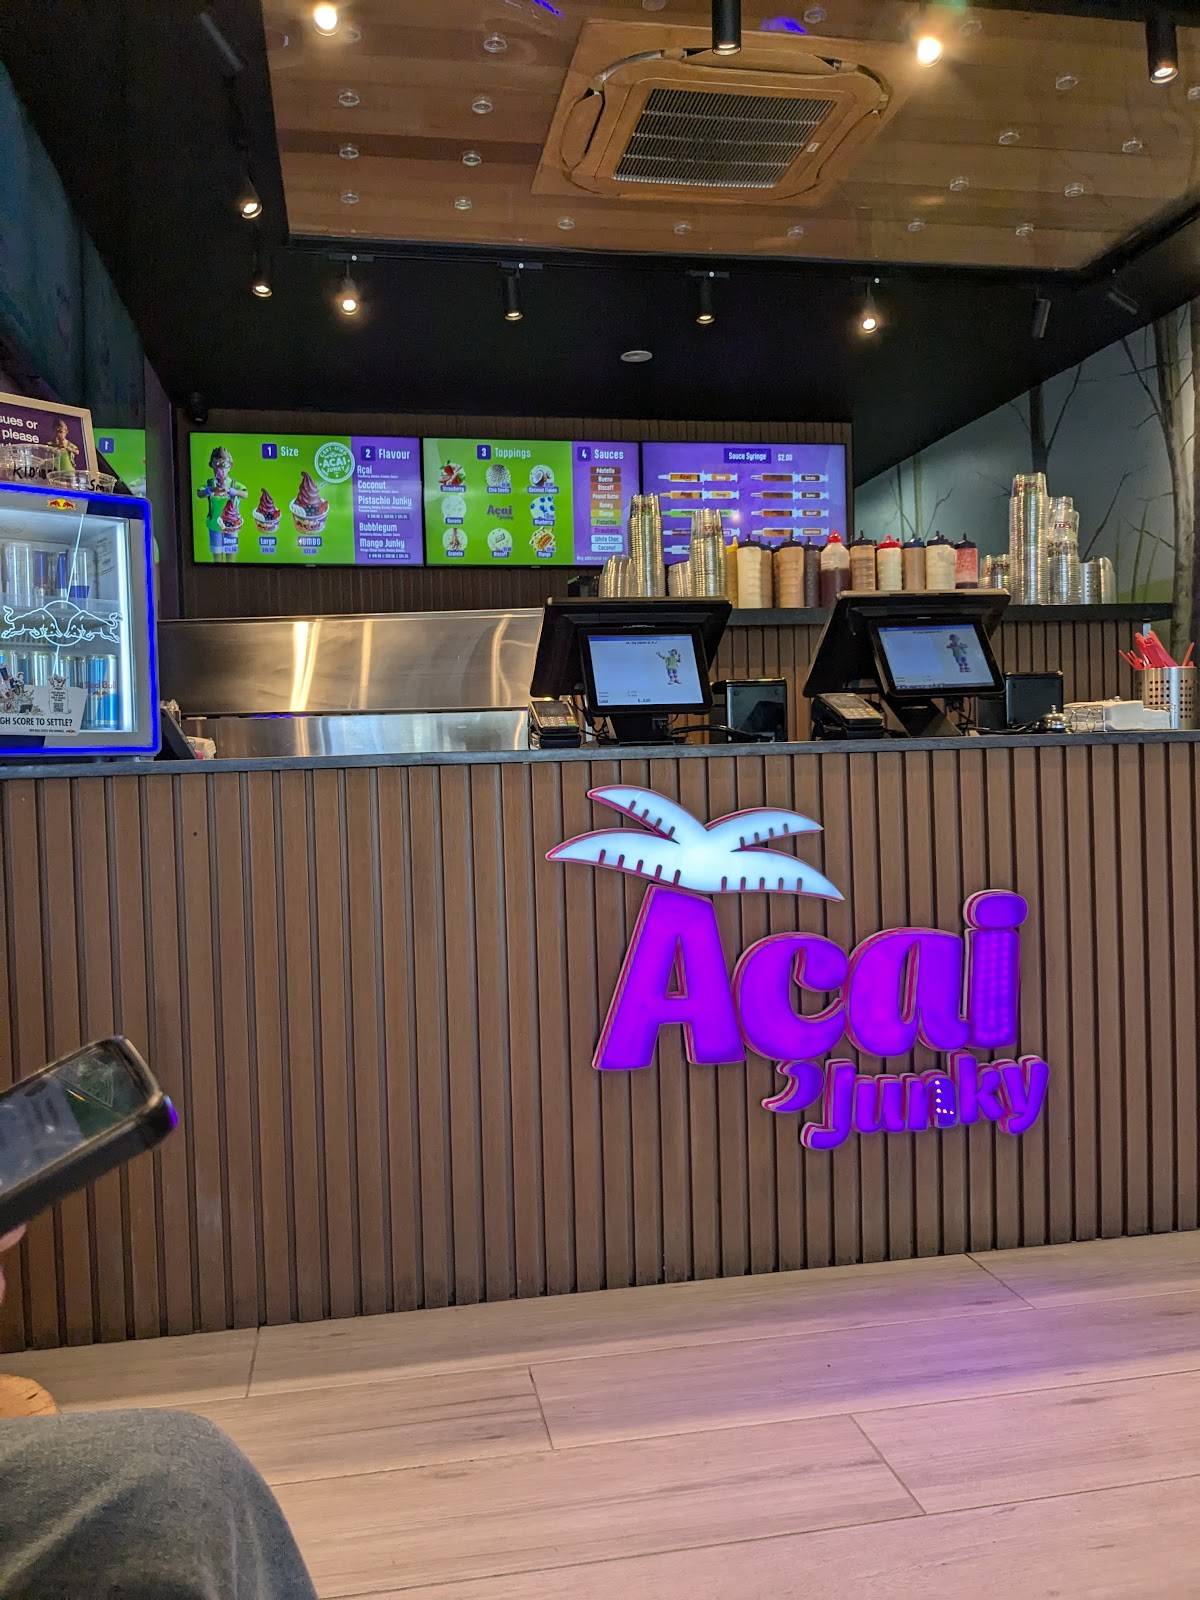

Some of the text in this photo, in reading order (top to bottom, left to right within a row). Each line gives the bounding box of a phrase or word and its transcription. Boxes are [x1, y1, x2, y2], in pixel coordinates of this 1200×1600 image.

[26, 420, 38, 430] or
[2, 428, 40, 444] please
[267, 446, 299, 457] 1 Size
[365, 448, 411, 460] 2 Flavour
[481, 447, 531, 459] 3 Toppings
[581, 448, 624, 460] 4 Sauces
[728, 451, 746, 460] Sauce
[746, 452, 767, 461] Syringe
[357, 480, 387, 490] Coconut
[358, 495, 413, 507] Pistachio Junky
[359, 522, 398, 533] Bubblegum
[359, 538, 406, 550] Mango Junky
[12, 717, 35, 726] SCORE
[35, 717, 45, 726] TO
[46, 718, 73, 727] SETTLE?
[590, 883, 1030, 1113] Açai
